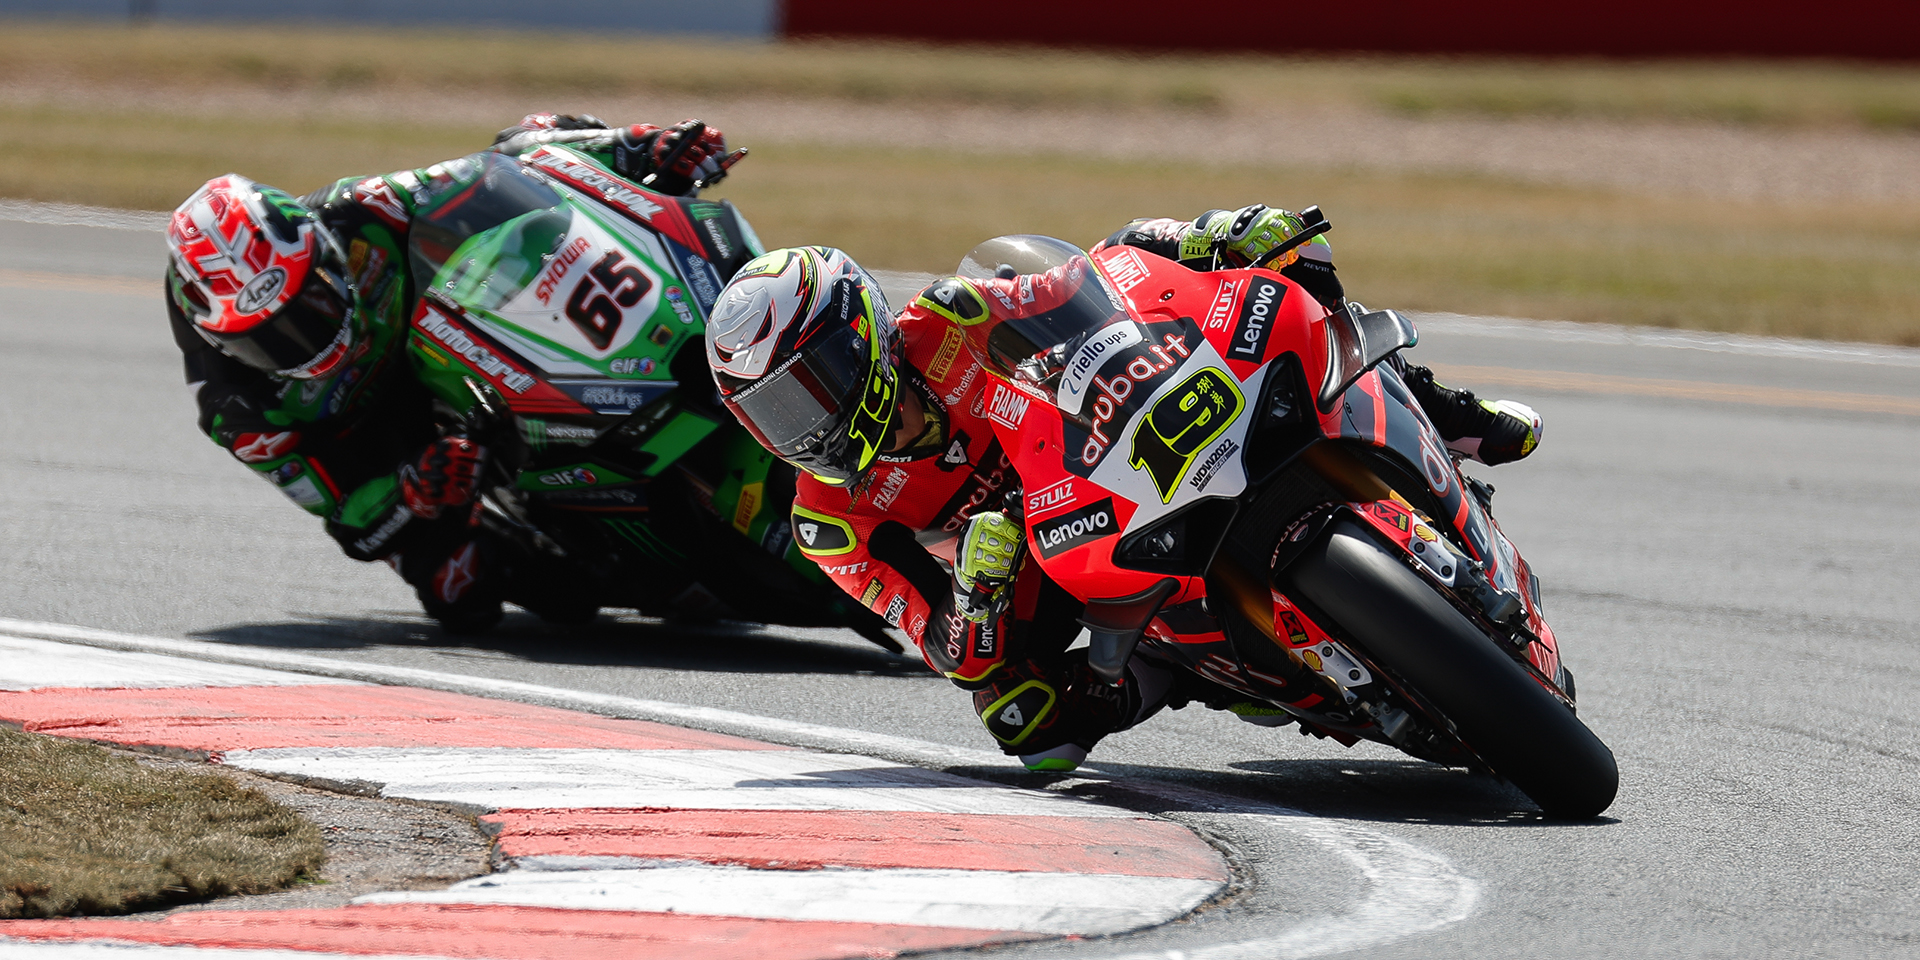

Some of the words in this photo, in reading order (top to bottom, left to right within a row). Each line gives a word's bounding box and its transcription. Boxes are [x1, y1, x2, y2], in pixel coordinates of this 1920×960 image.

[534, 236, 592, 306] SHOWA
[1102, 251, 1146, 293] FIAMM
[564, 250, 653, 350] 65
[1209, 280, 1237, 329] STULZ
[1235, 284, 1277, 355] Lenovo
[417, 304, 534, 393] Motocard
[857, 315, 869, 339] 19
[741, 385, 756, 397] EDILE
[754, 371, 777, 389] BALDINI
[774, 352, 803, 375] CORRADO
[925, 326, 963, 383] PIRELLI
[1073, 340, 1106, 380] riello
[1105, 329, 1128, 346] ups
[990, 384, 1030, 426] FIAMM
[1081, 333, 1191, 467] aruba.it
[1128, 366, 1246, 504] 19
[1189, 438, 1235, 488] WDW2022
[872, 466, 909, 512] FIAMM
[1029, 483, 1074, 511] STULZ
[1037, 511, 1110, 550] Lenovo
[819, 561, 868, 576] V'IT!
